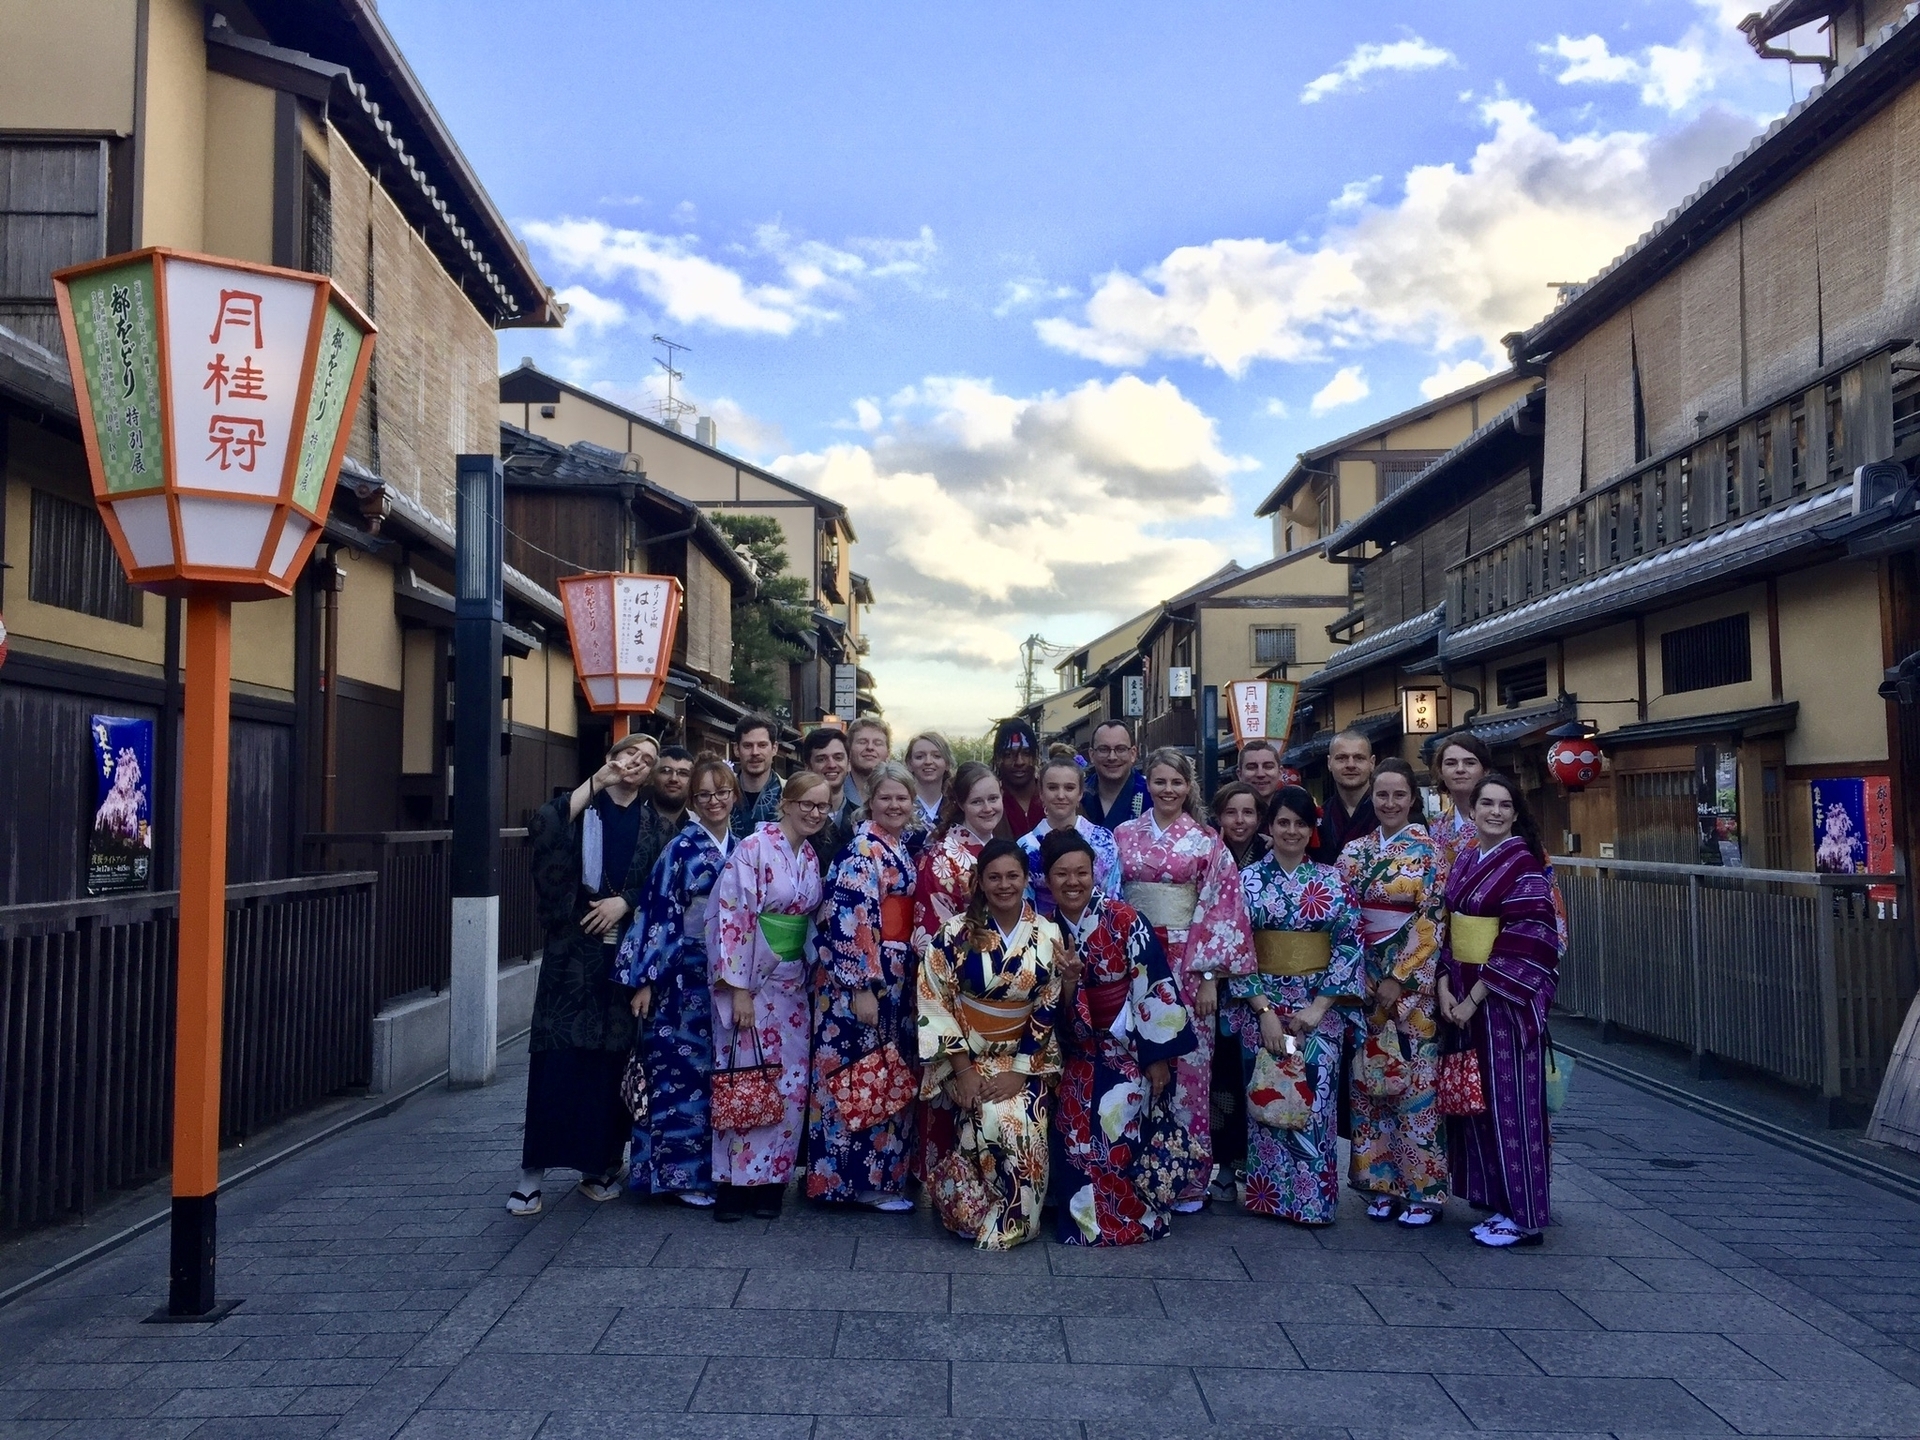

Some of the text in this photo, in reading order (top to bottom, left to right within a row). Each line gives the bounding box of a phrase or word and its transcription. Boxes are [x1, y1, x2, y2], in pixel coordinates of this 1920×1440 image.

[111, 284, 135, 399] 都をどり
[125, 405, 146, 473] 特別展
[203, 289, 268, 472] 月桂冠
[315, 322, 344, 421] 都をどり
[633, 590, 650, 646] はれま
[650, 583, 662, 629] チリメン山椒
[1244, 686, 1260, 732] 月桂冠
